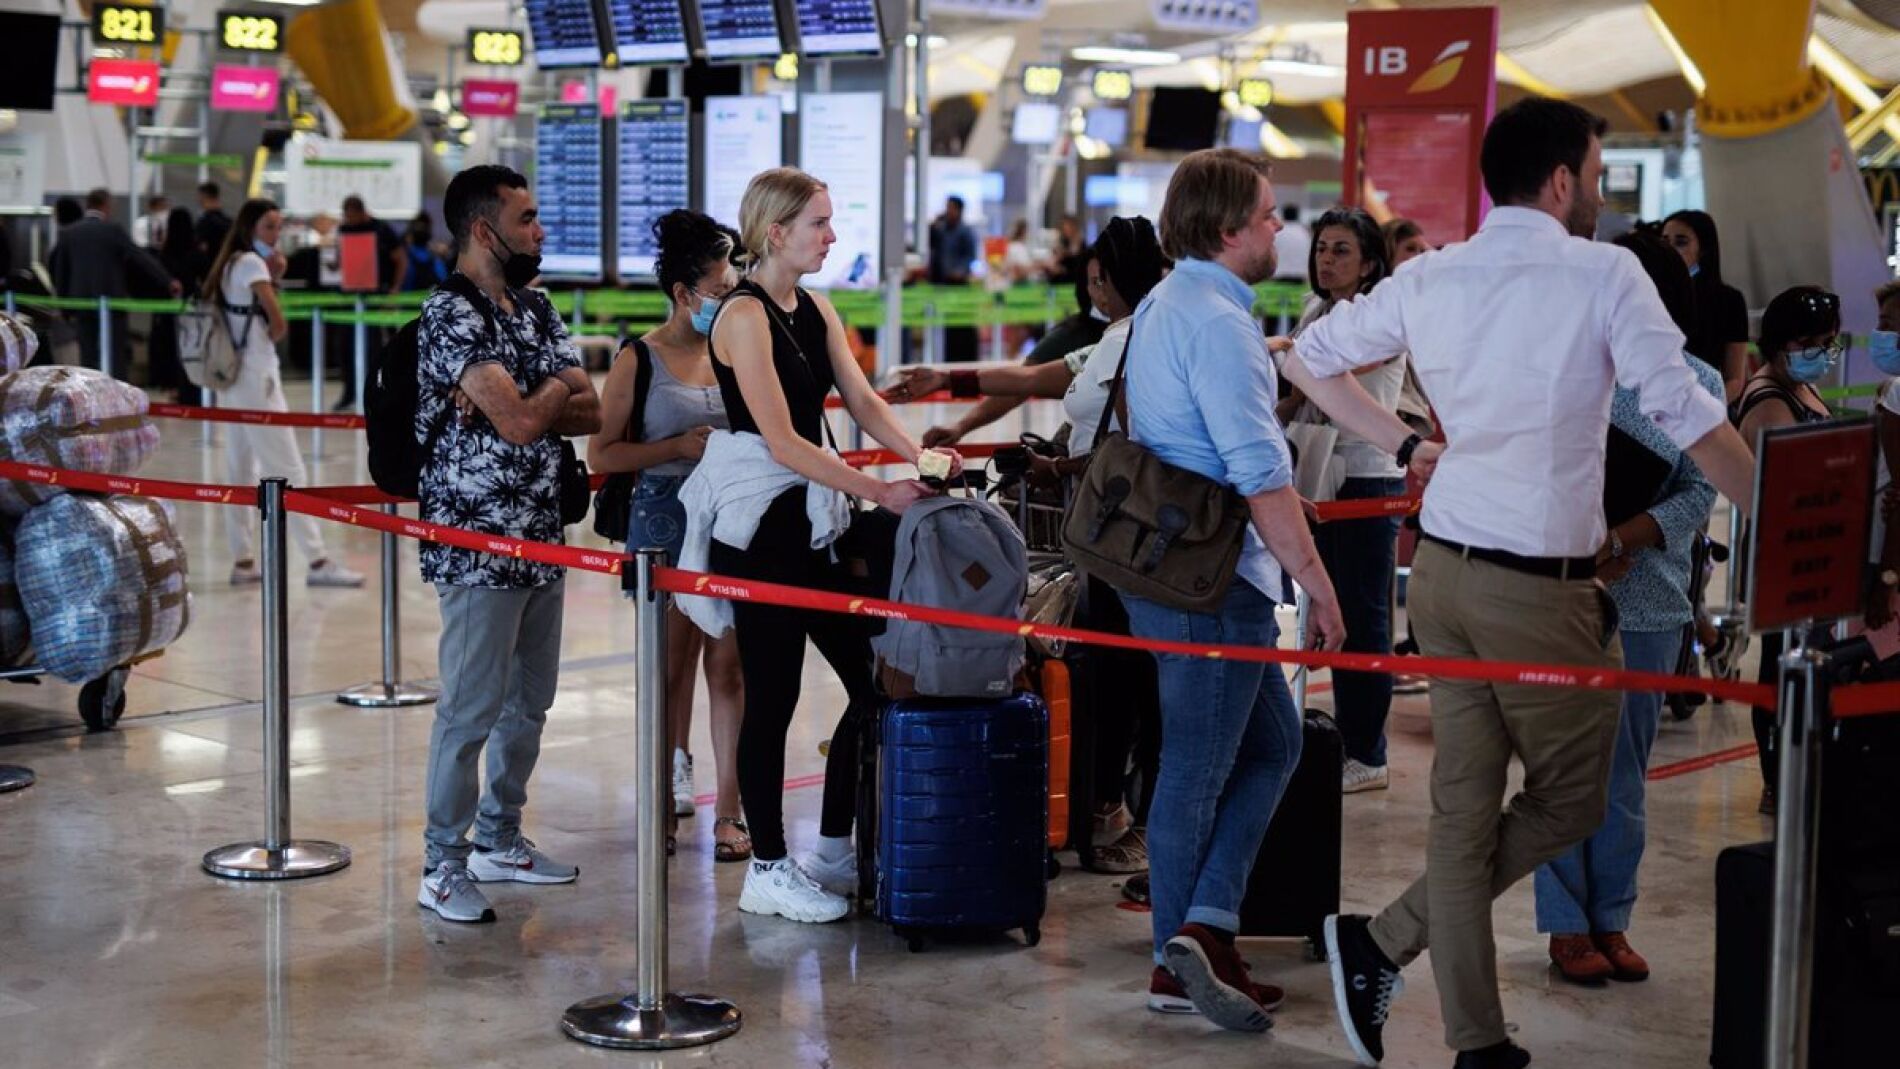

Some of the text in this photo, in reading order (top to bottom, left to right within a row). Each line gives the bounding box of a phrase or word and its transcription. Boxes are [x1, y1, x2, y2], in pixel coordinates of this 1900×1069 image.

[101, 8, 155, 41] 821
[1364, 47, 1408, 75] IB
[196, 488, 221, 498] IBERIA
[404, 524, 427, 536] IBERIA
[487, 541, 512, 553] IBERIA
[581, 554, 609, 568] IBERIA
